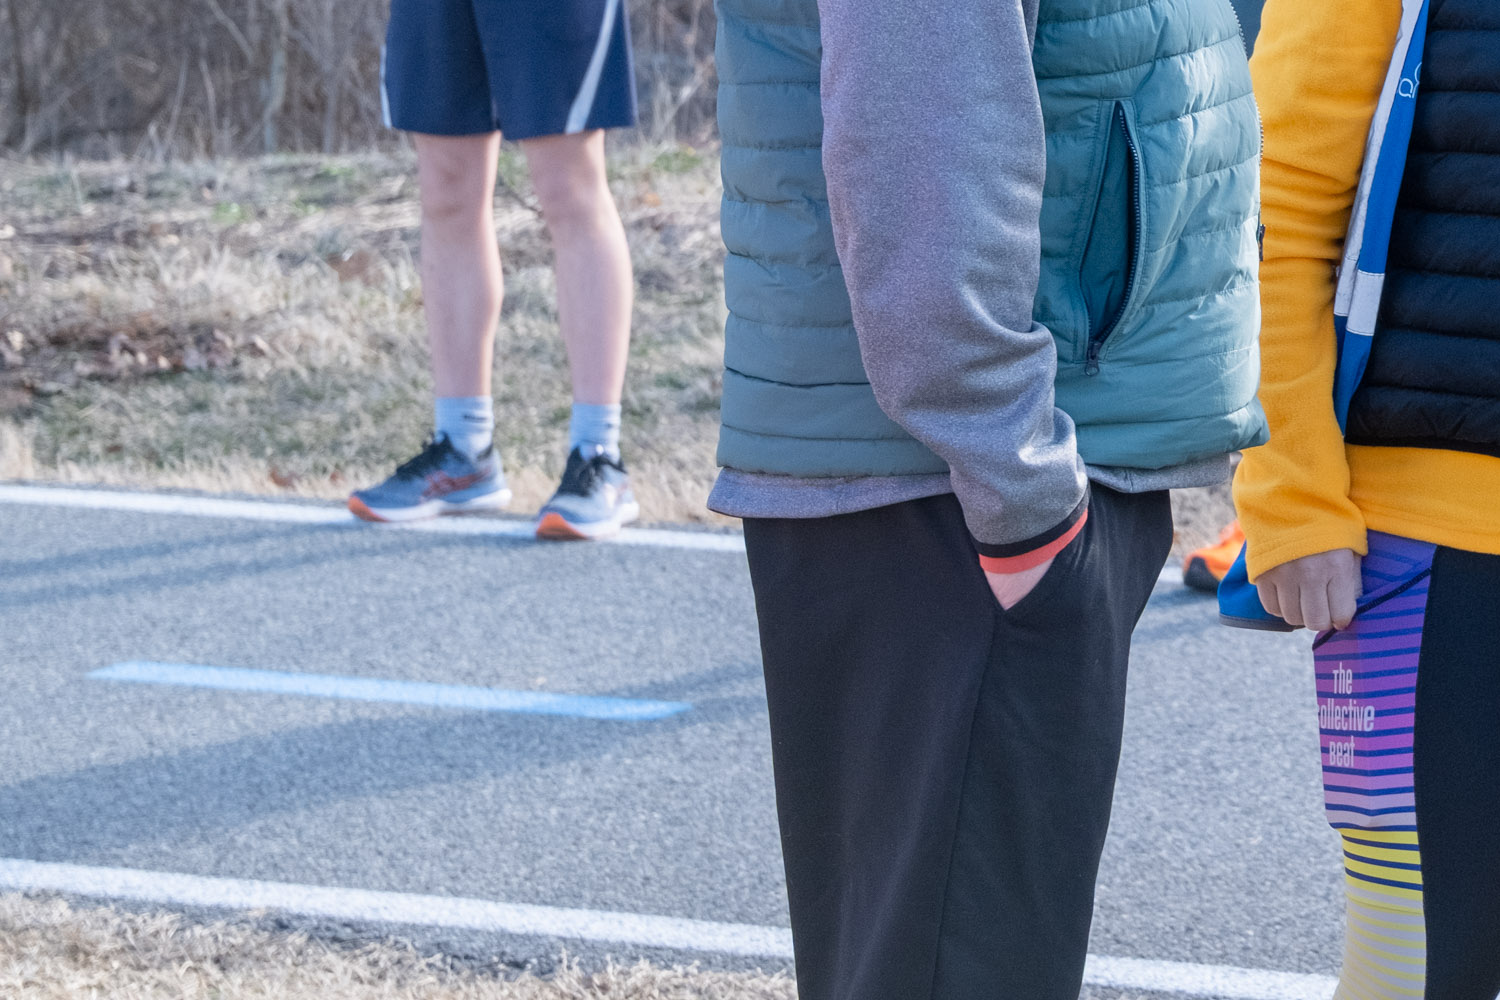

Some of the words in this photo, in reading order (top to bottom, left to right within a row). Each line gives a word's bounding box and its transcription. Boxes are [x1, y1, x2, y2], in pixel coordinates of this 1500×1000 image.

[1333, 661, 1353, 695] The
[1318, 698, 1375, 732] ollective
[1329, 735, 1355, 768] Beat
